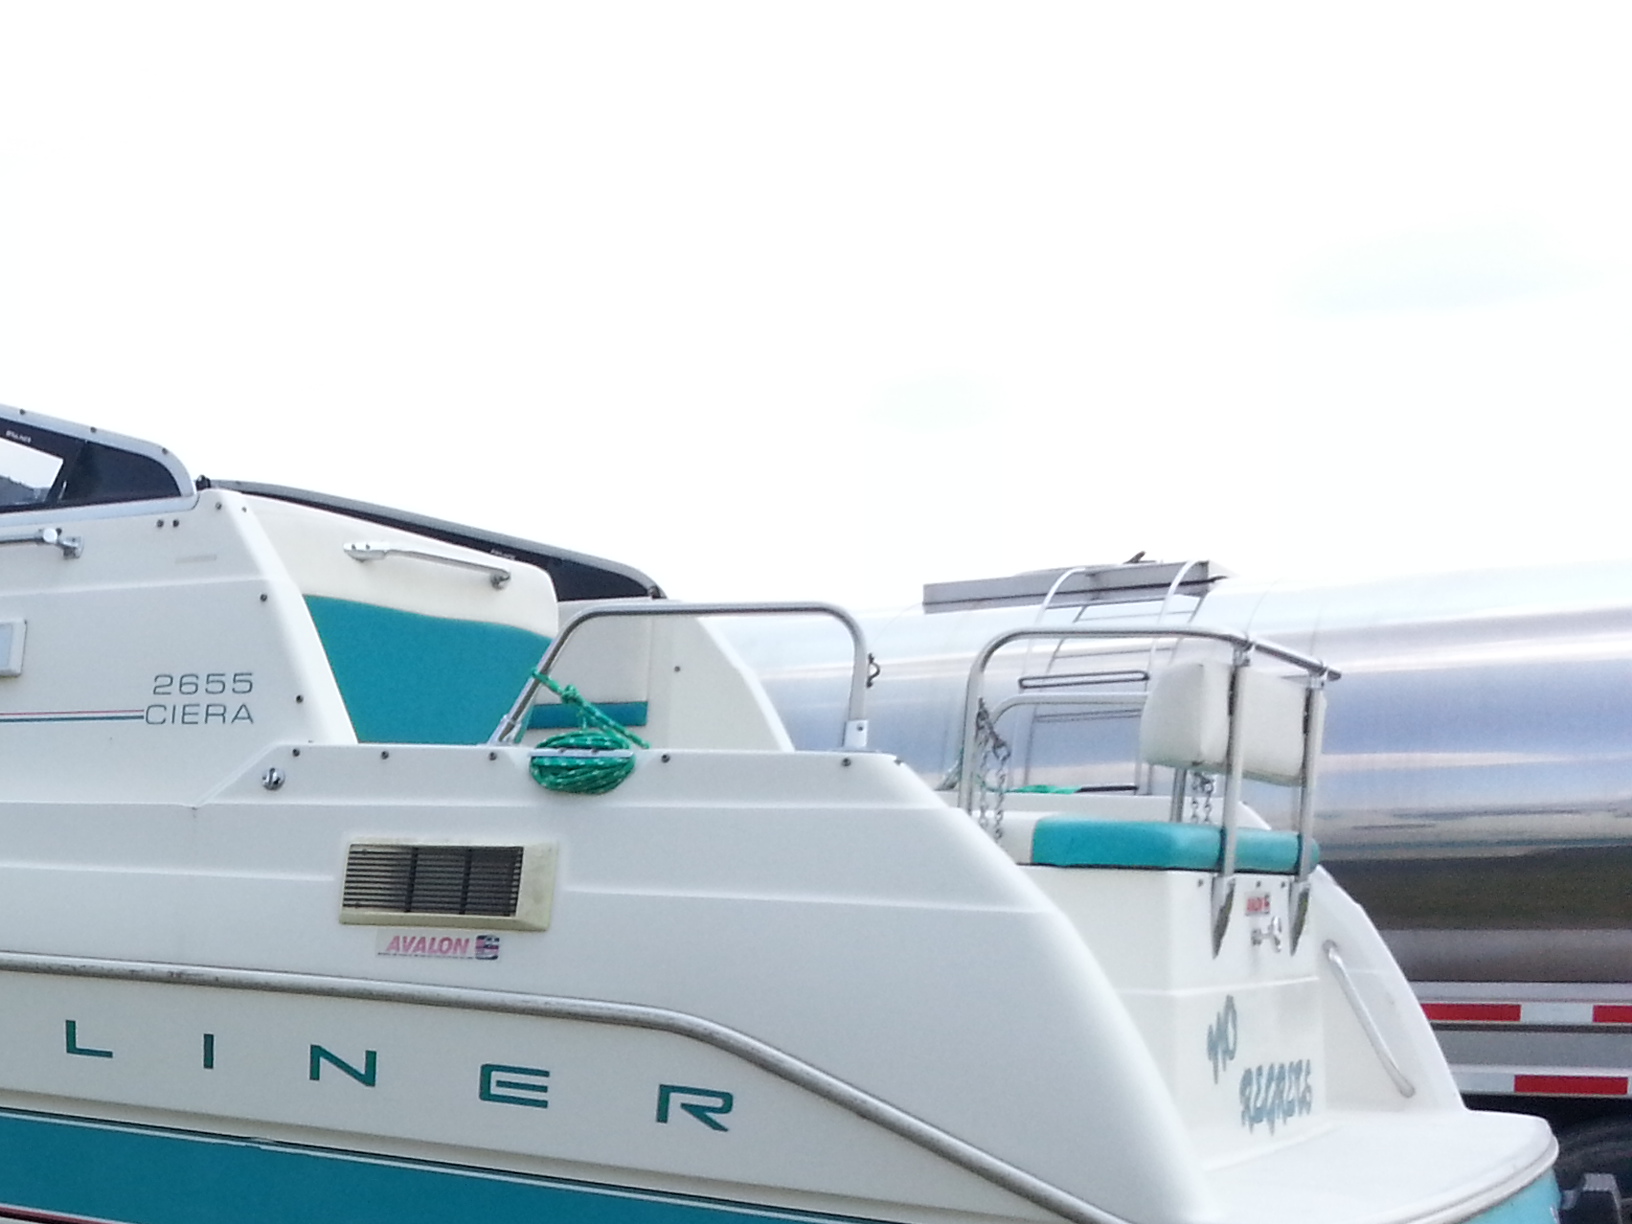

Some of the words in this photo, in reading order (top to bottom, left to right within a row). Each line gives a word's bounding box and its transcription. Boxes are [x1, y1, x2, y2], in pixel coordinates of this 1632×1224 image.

[152, 672, 254, 696] 2655
[145, 702, 255, 725] CIERA
[386, 934, 471, 955] AVALON
